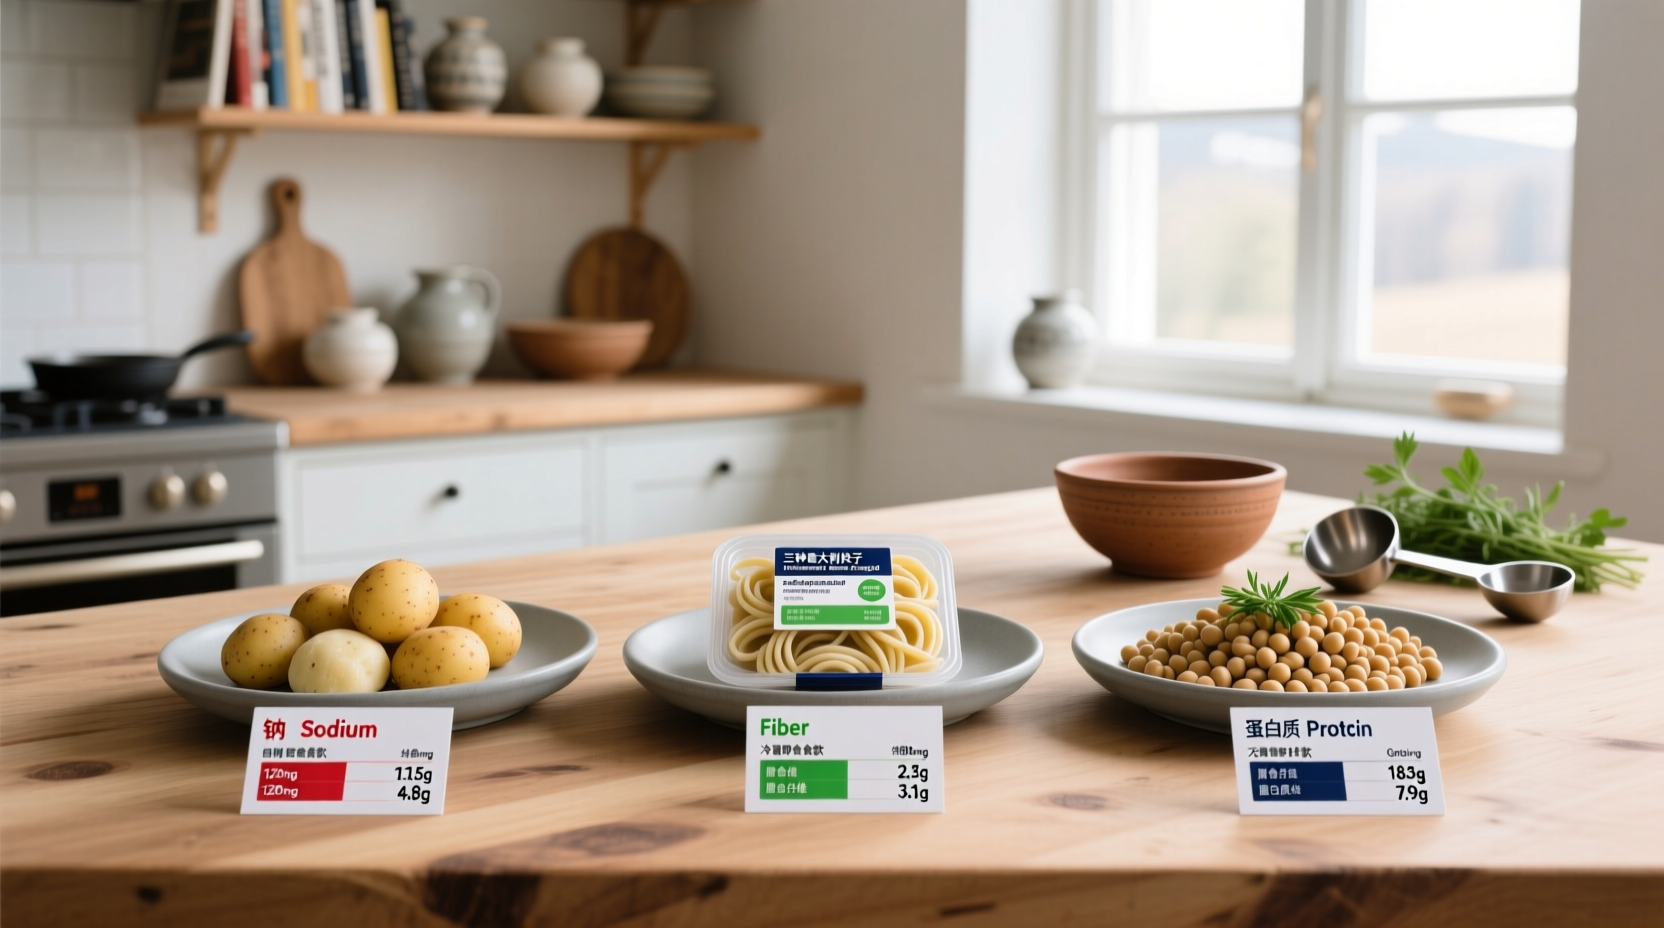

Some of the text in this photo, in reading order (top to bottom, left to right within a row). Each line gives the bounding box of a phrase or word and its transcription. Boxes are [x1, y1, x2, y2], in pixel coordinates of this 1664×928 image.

[263, 718, 378, 741] 钠 Sodium
[760, 717, 810, 736] Fiber
[1245, 718, 1301, 739] 蛋白质
[897, 764, 929, 783] 2.3g
[397, 785, 431, 804] 4.8g
[897, 784, 929, 803] 3.1g
[1395, 785, 1429, 805] 7.9g
